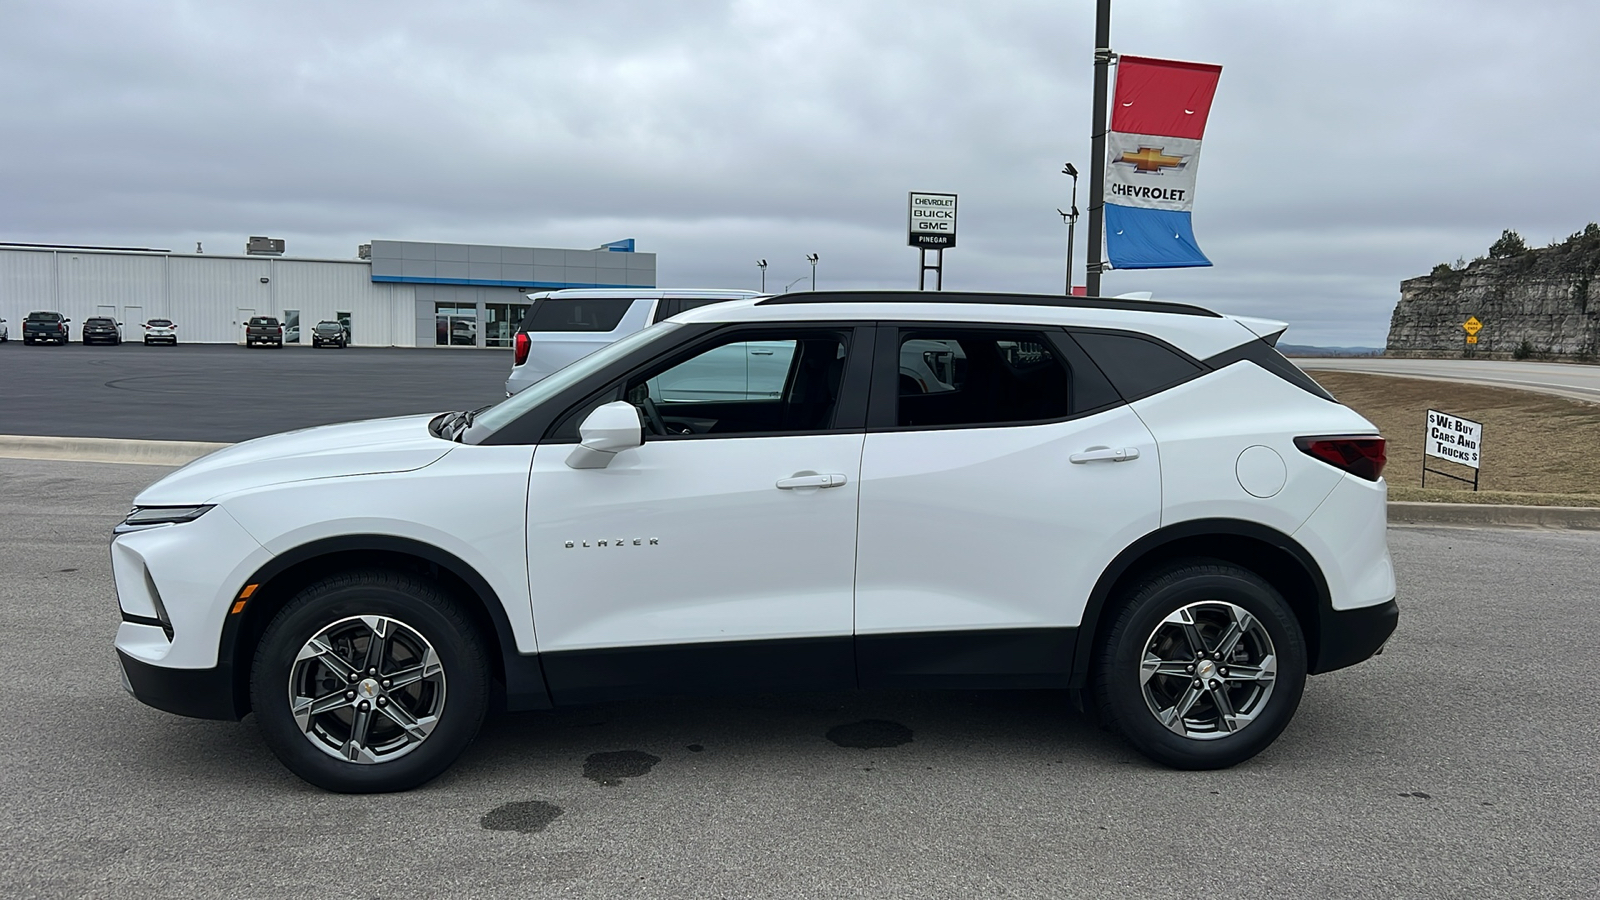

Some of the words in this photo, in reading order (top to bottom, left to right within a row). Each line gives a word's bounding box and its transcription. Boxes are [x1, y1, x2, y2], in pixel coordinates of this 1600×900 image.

[915, 198, 953, 206] CHEVROLET
[914, 210, 953, 218] BUICK
[919, 222, 948, 230] GMC
[565, 537, 659, 548] BLAZER
